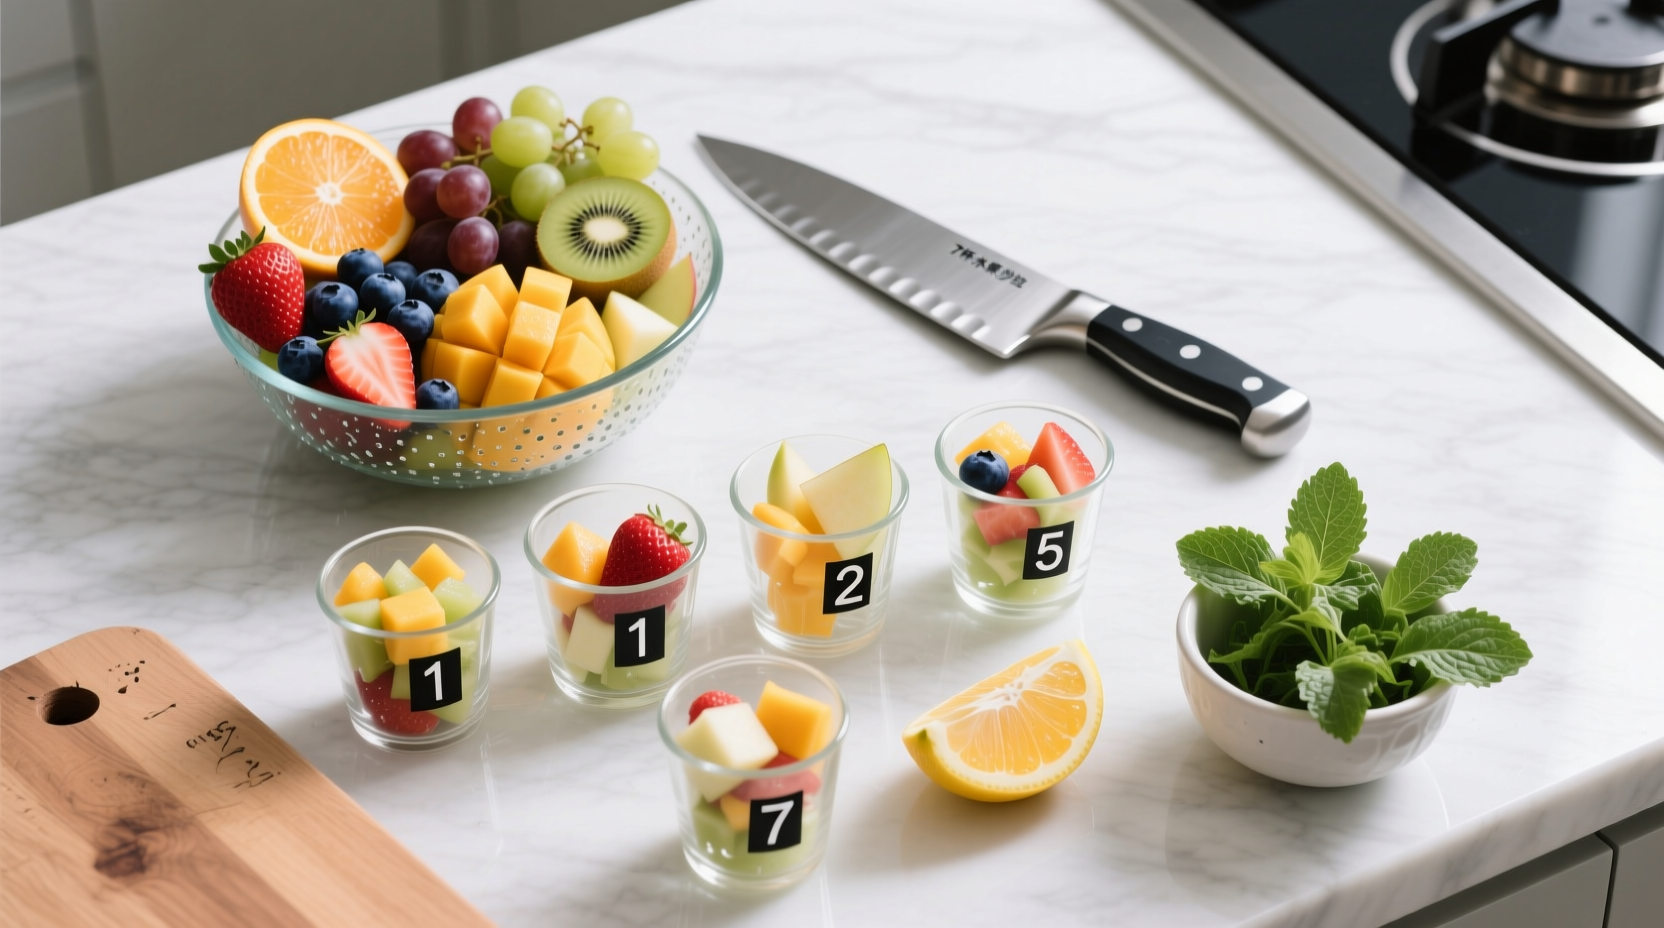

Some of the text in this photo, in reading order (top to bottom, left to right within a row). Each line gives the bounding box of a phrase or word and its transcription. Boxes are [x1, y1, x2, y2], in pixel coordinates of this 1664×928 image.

[1035, 530, 1064, 572] 5
[834, 564, 864, 606] 2
[628, 617, 646, 658] 1
[424, 660, 443, 701] 1
[761, 800, 794, 845] 7
